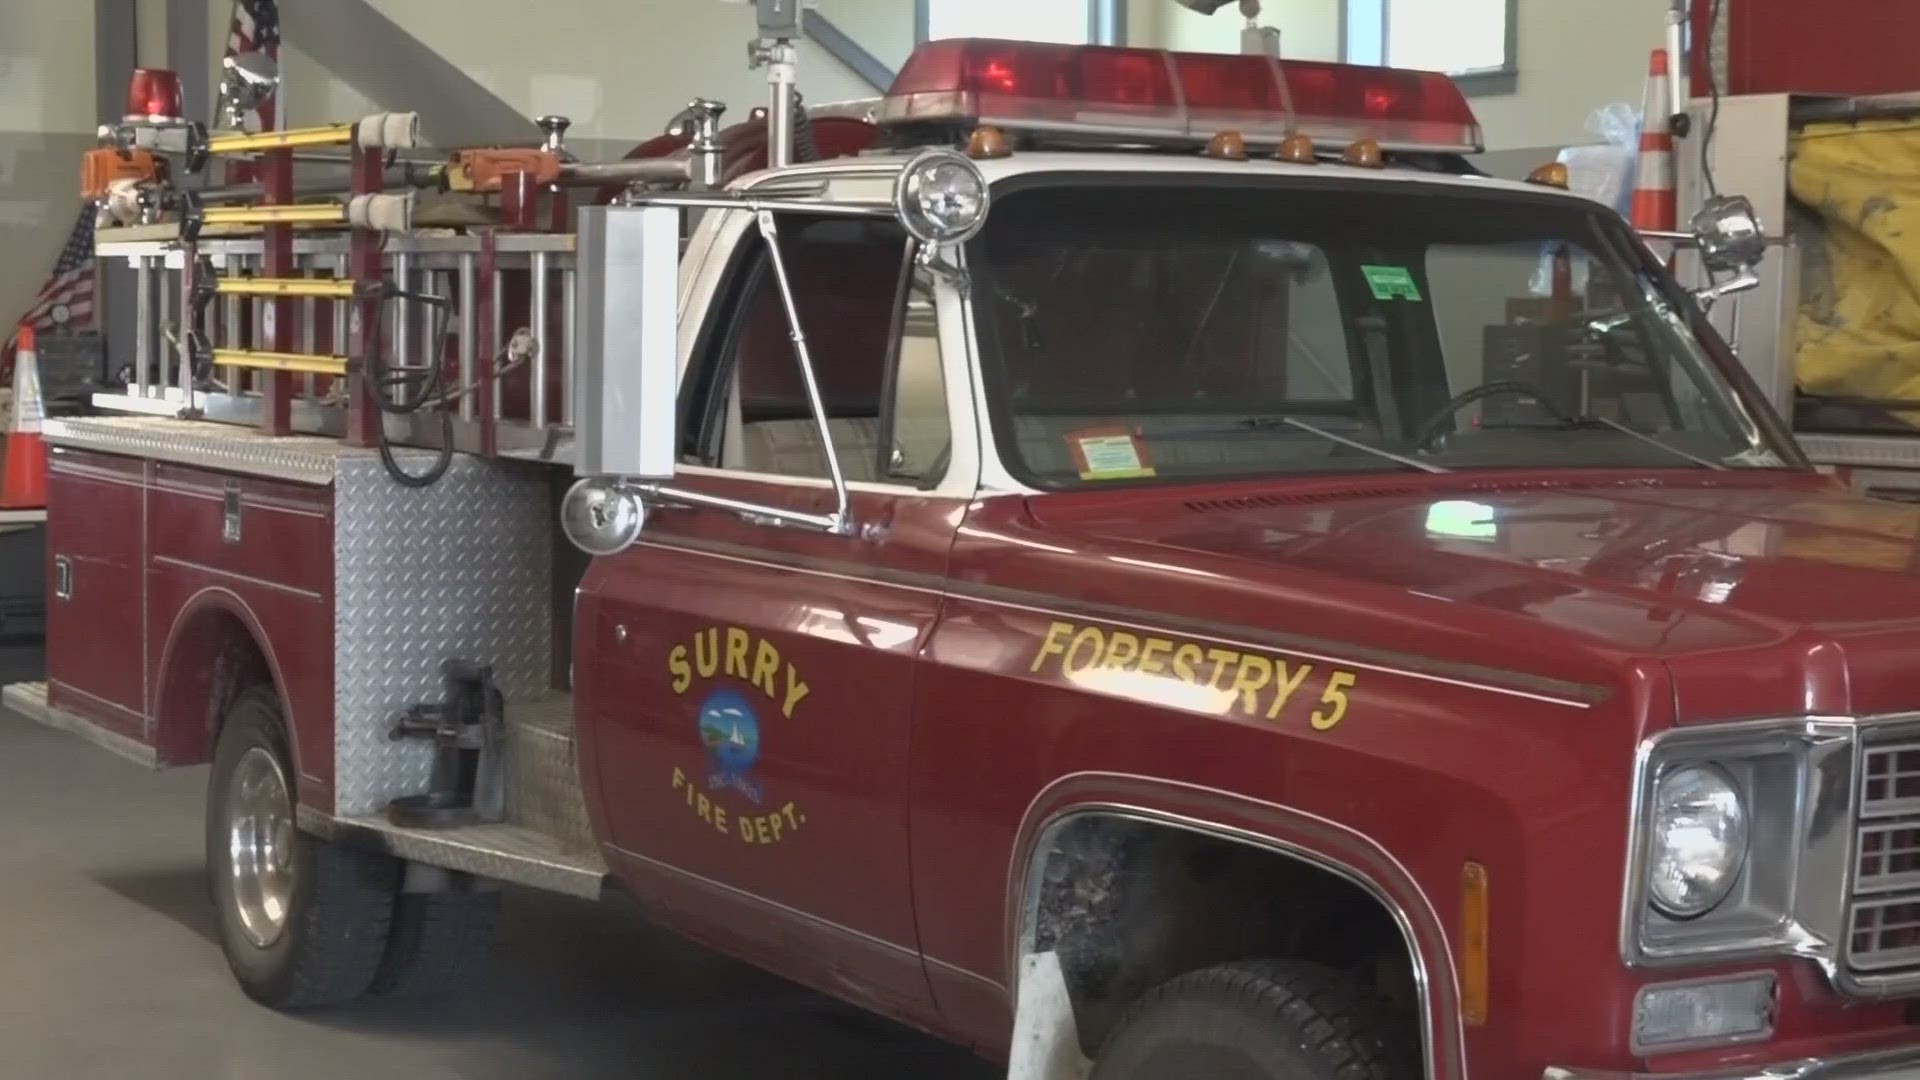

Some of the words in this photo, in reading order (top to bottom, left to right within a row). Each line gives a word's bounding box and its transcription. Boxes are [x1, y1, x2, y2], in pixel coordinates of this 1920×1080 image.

[669, 627, 809, 719] SURRY
[1030, 621, 1313, 719] FORESTRY
[1311, 670, 1356, 730] 5
[672, 767, 728, 834] FIRE
[739, 802, 806, 844] DEPT.
